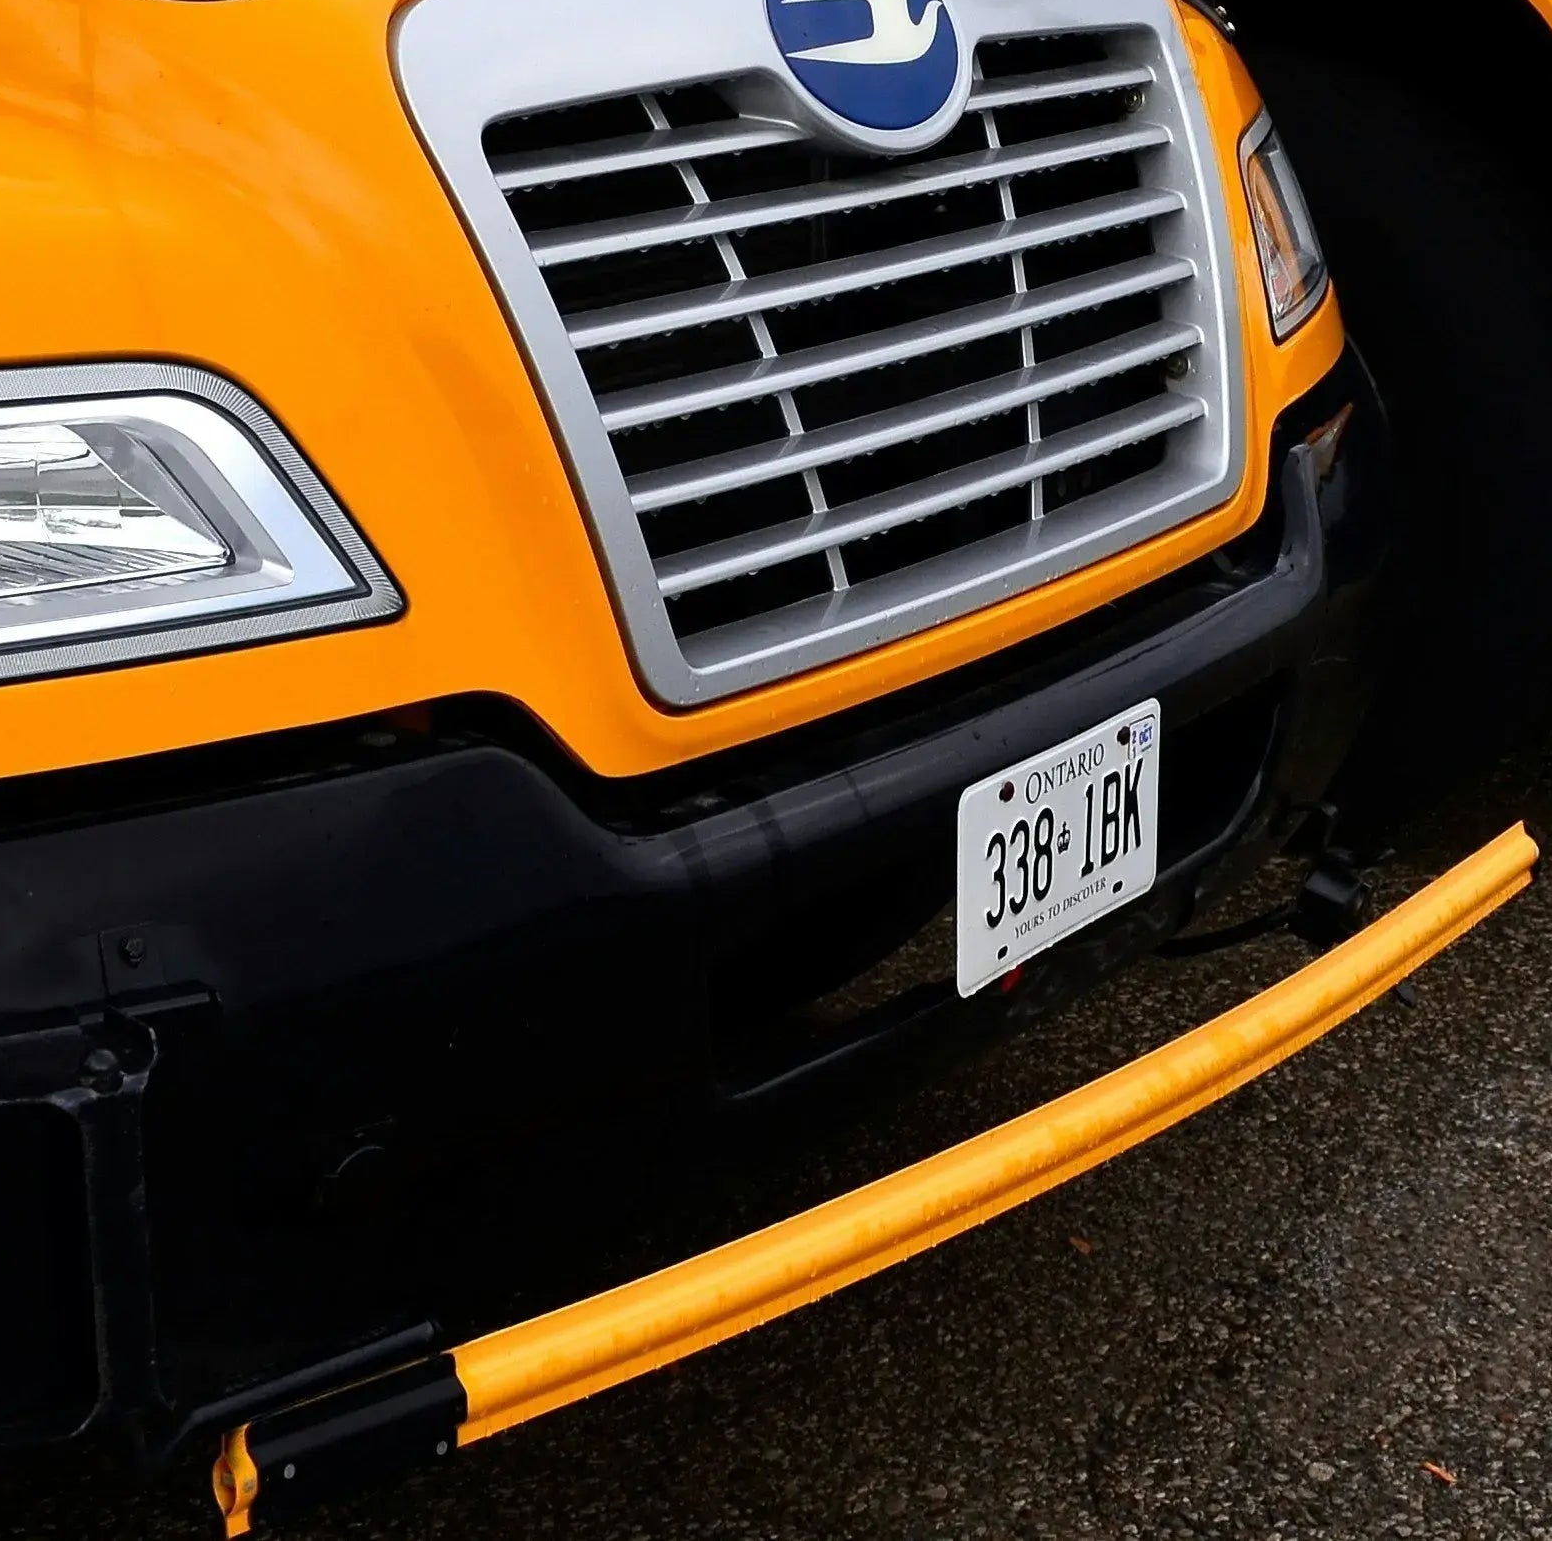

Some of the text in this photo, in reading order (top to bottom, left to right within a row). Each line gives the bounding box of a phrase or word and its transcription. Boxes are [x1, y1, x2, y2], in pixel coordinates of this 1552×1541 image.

[1025, 743, 1104, 804] ONTARIO
[985, 758, 1144, 929] 338 1BK
[1015, 877, 1107, 939] YOURS TO DISCOVER
